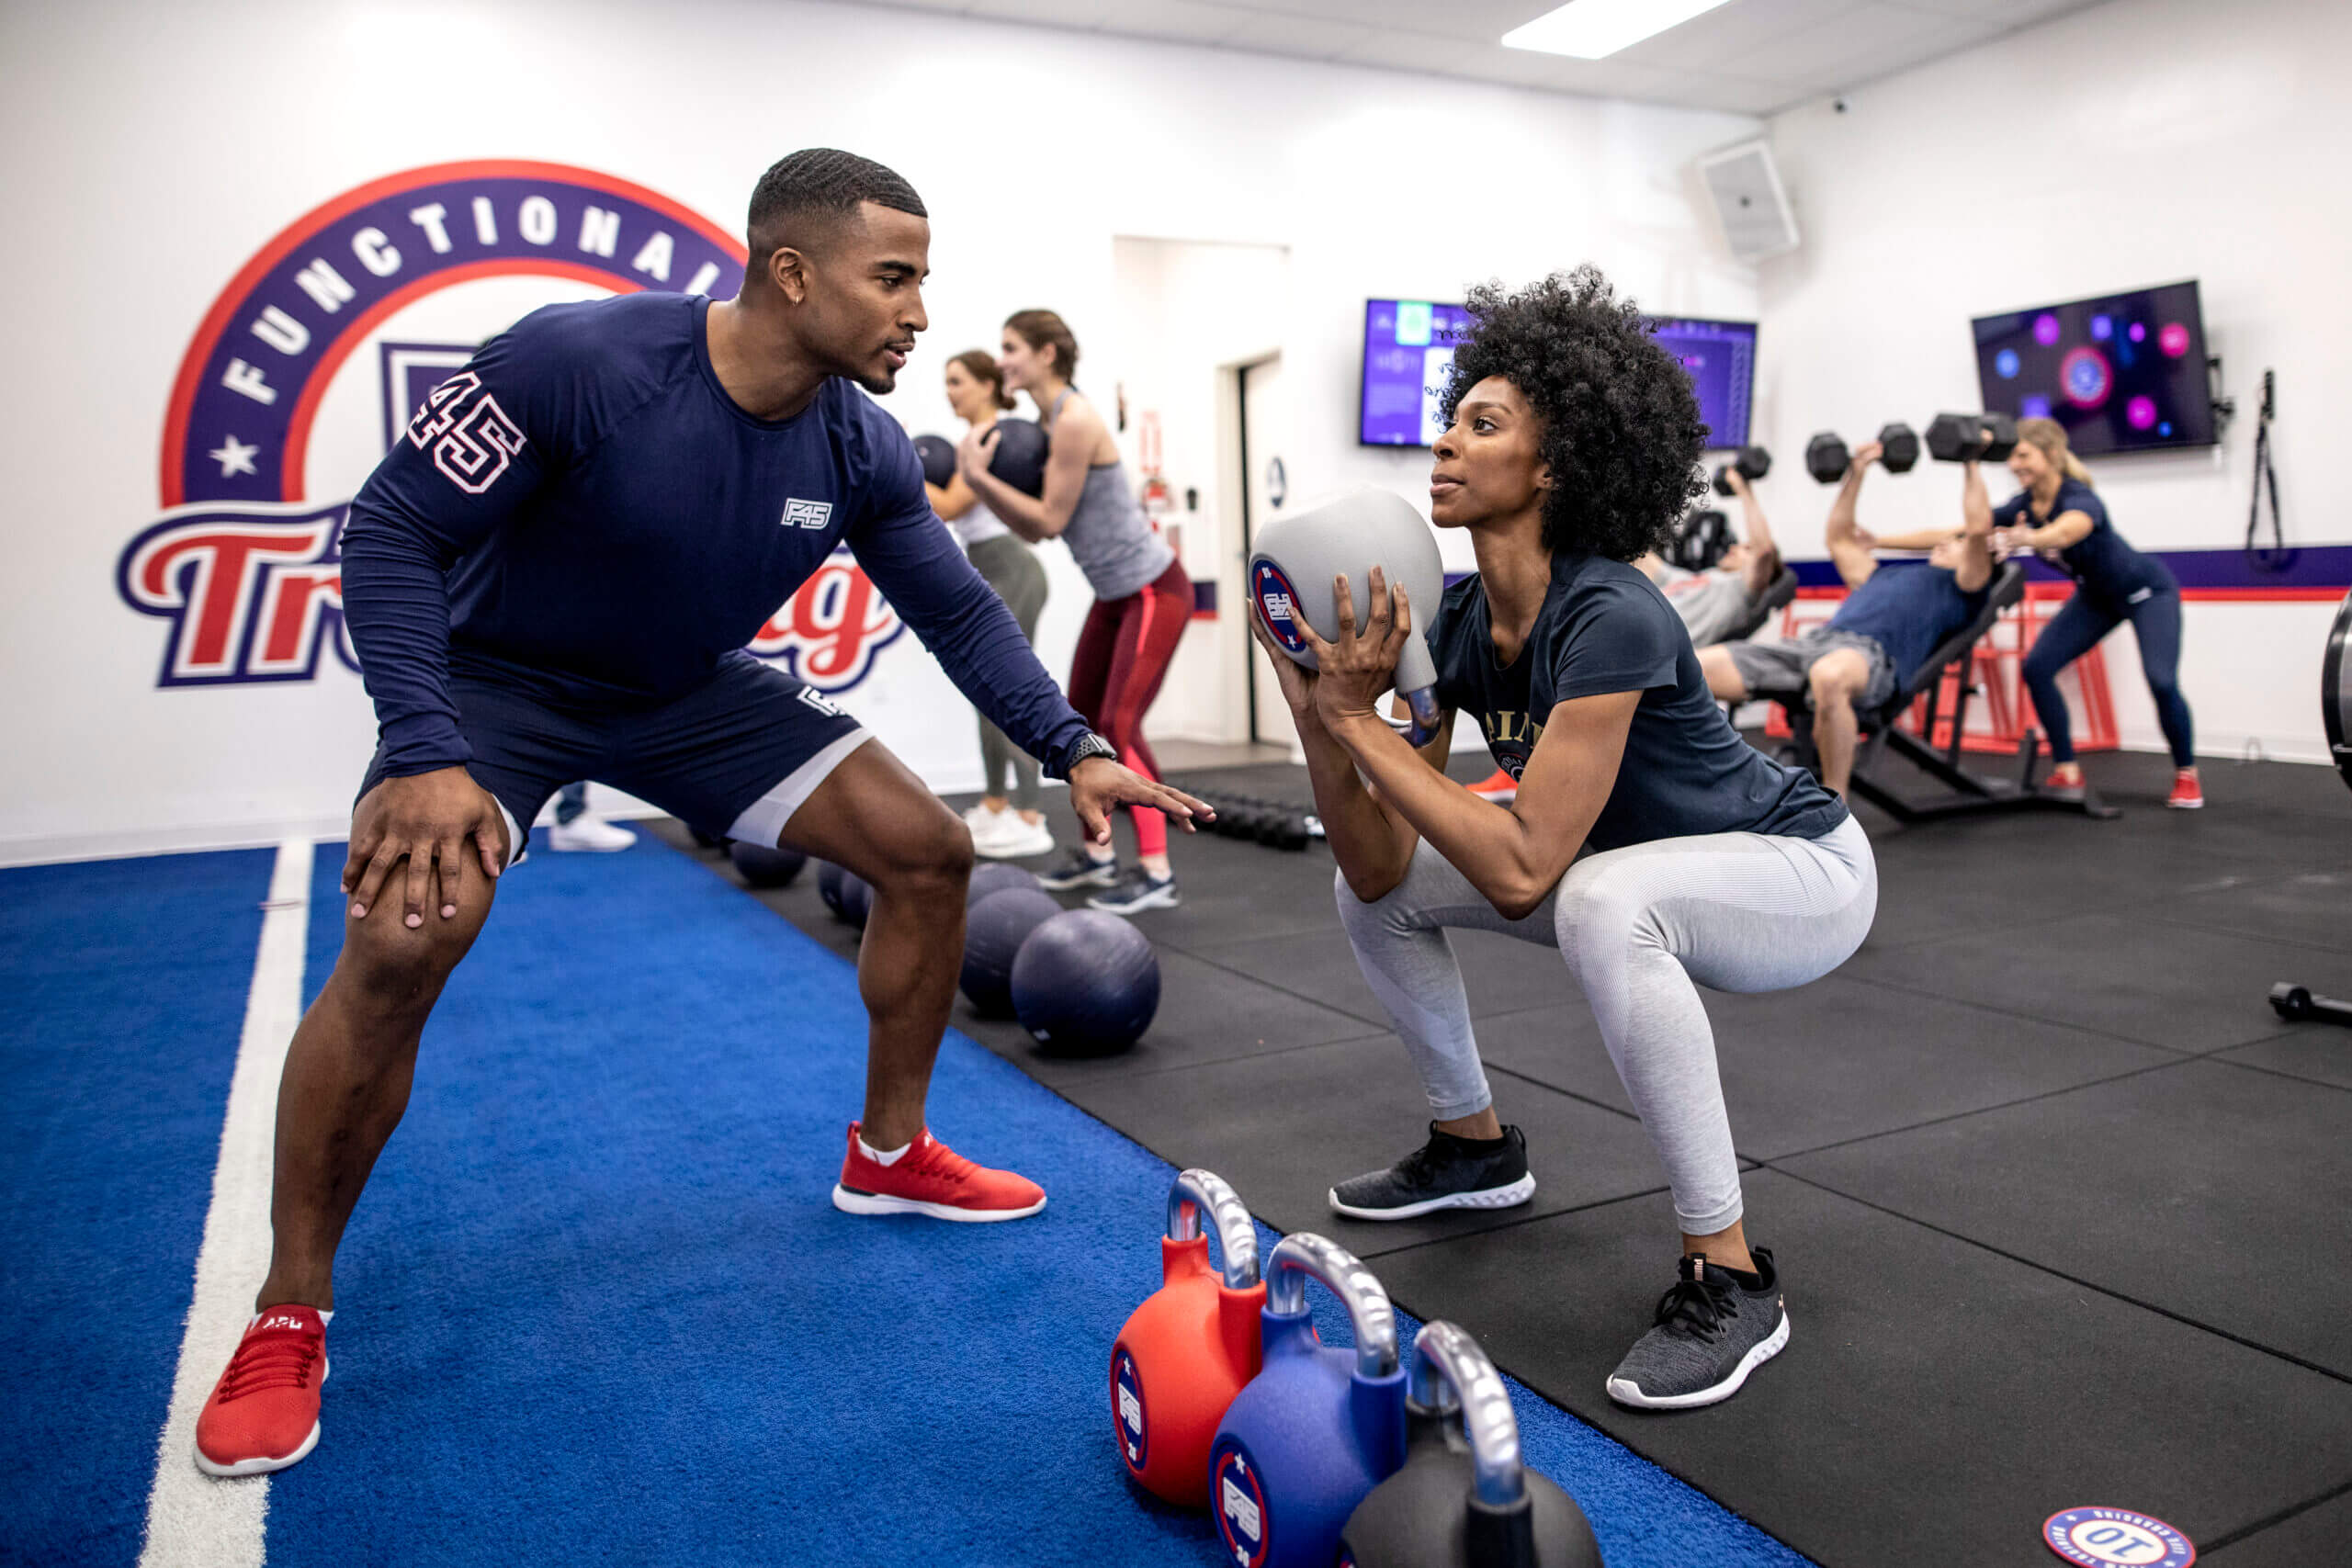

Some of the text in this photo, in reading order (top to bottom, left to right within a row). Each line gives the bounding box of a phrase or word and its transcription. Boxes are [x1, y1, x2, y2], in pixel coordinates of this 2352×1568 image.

[221, 195, 721, 406] FUNCTIONAL
[407, 370, 527, 494] 45
[780, 497, 833, 530] F45
[263, 1316, 302, 1329] APL
